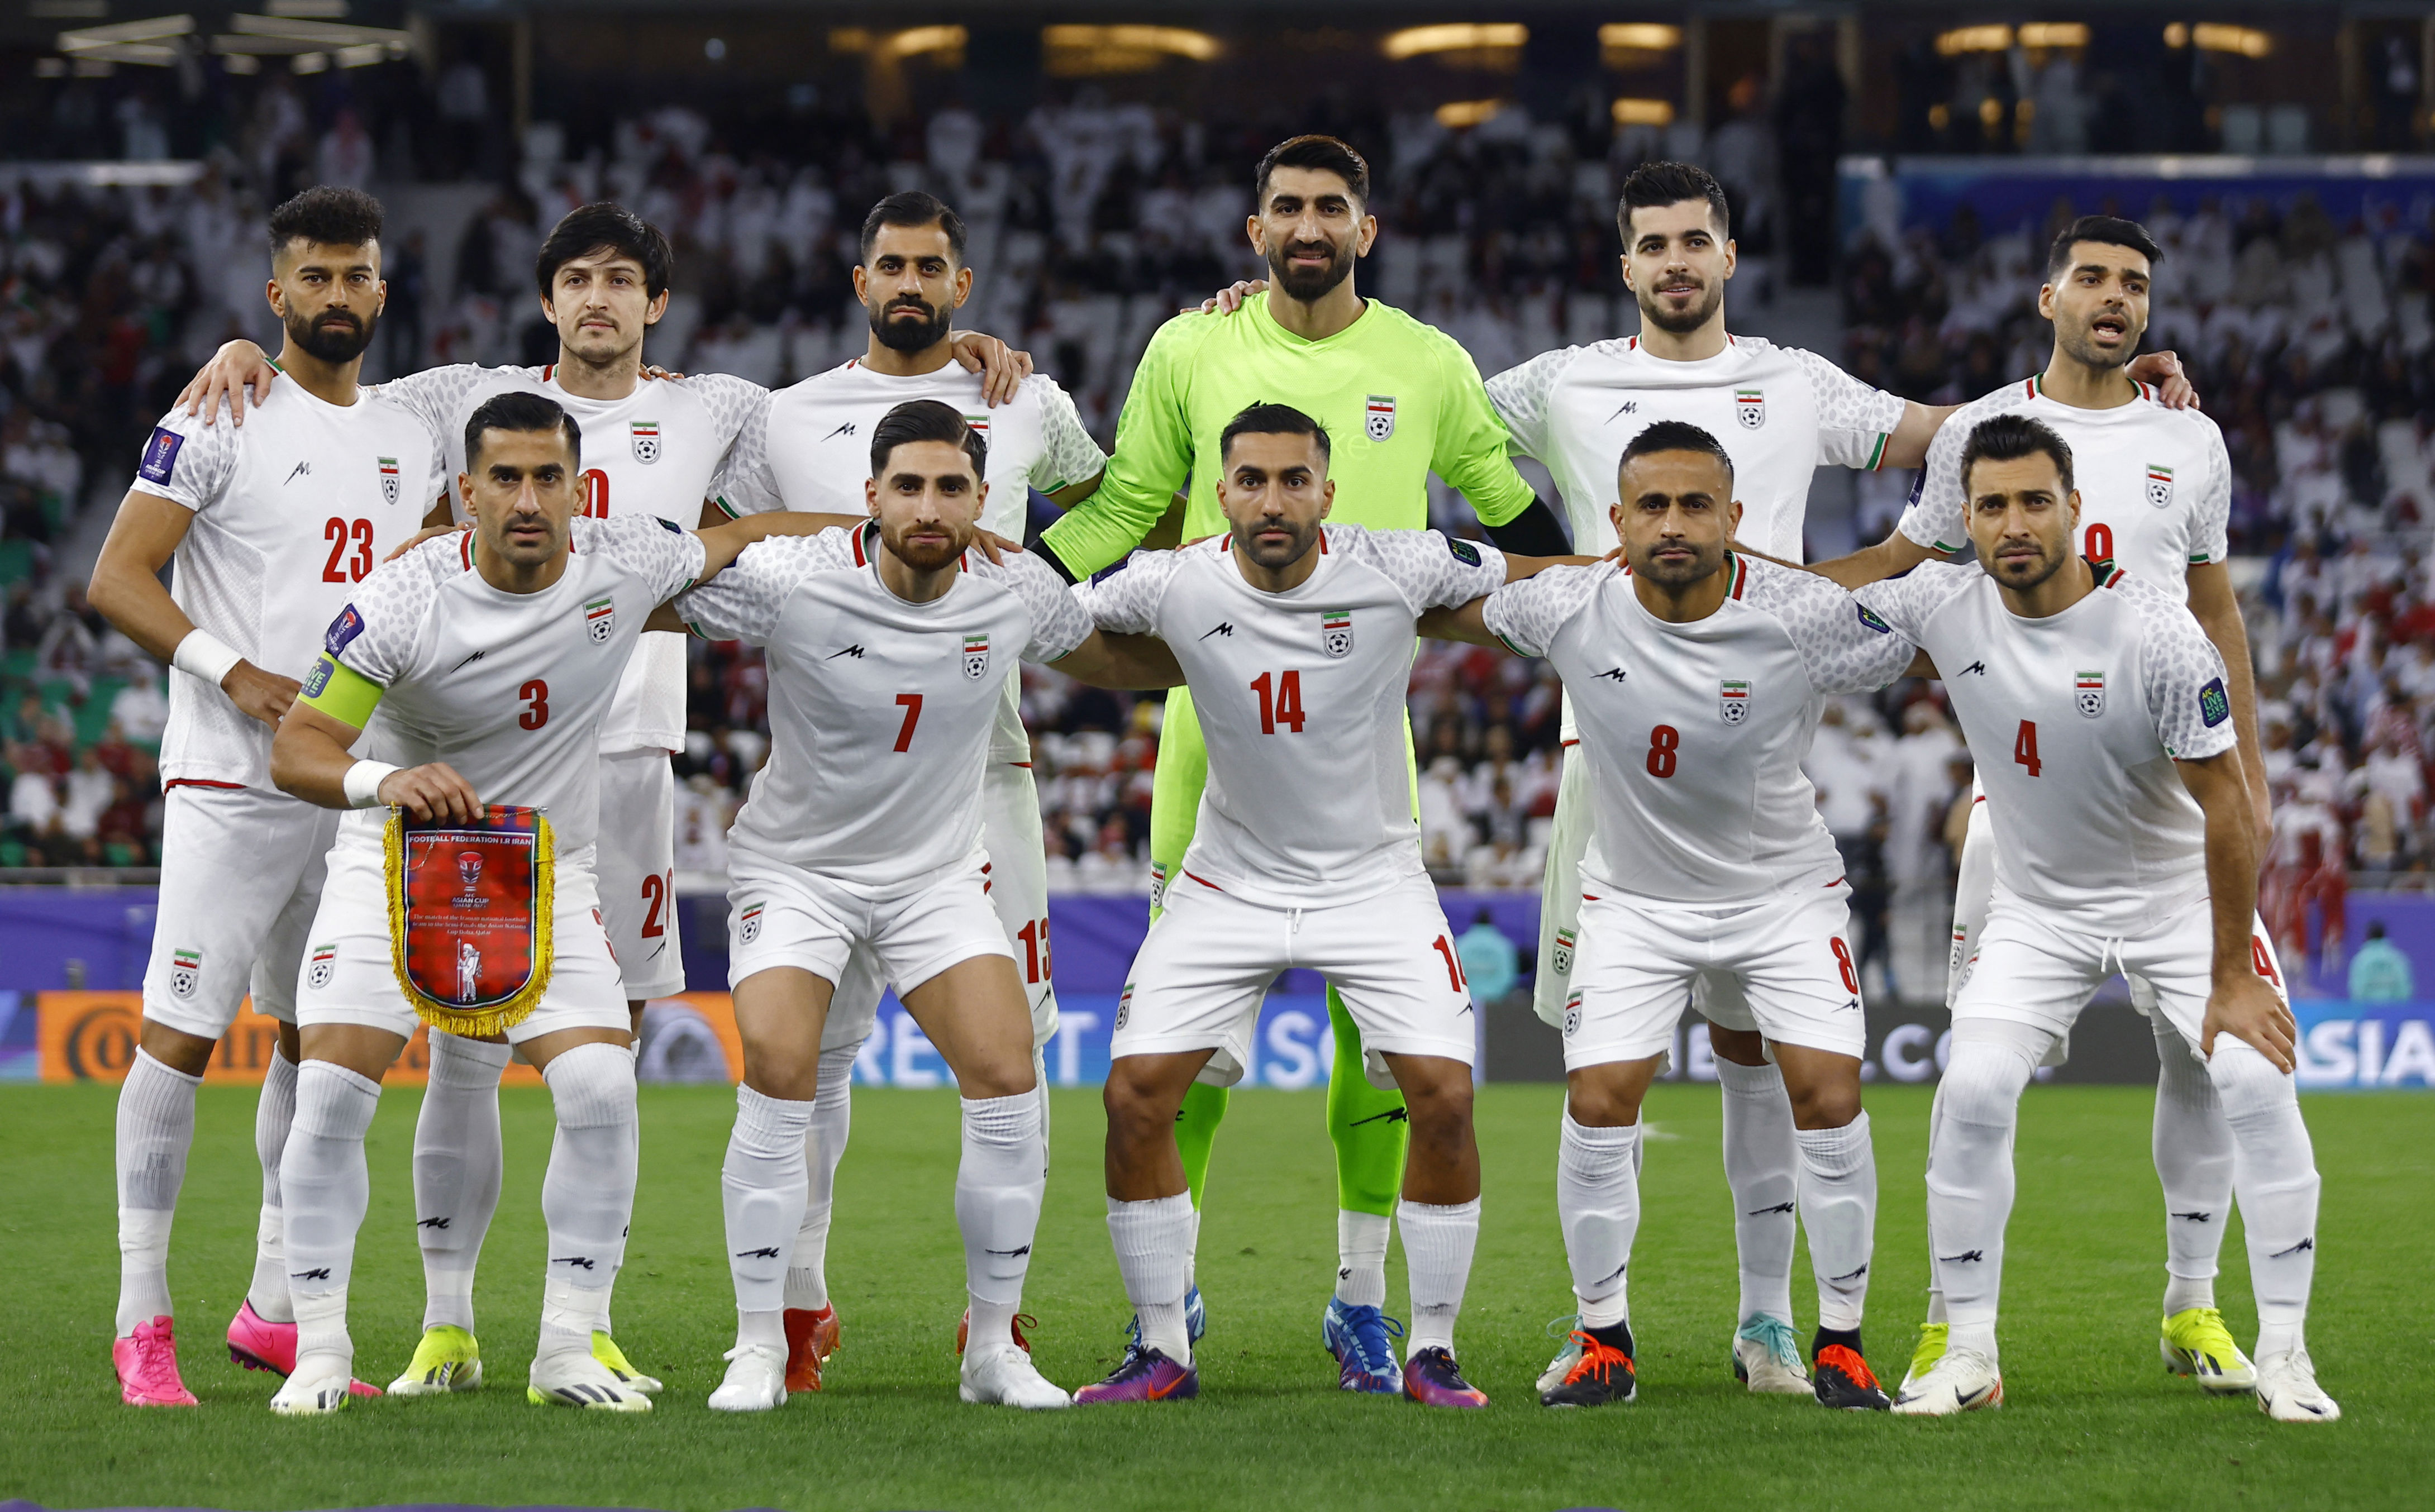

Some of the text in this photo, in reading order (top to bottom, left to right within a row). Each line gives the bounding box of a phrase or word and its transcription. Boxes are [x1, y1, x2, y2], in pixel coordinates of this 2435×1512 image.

[322, 517, 373, 583] 23
[519, 679, 548, 730] 3
[893, 694, 923, 752] 7
[1251, 670, 1305, 734] 14
[1646, 724, 1679, 778] 8
[2014, 719, 2042, 777] 4
[1018, 917, 1051, 984] 13
[1830, 936, 1858, 995] 8
[2252, 934, 2281, 988] 4
